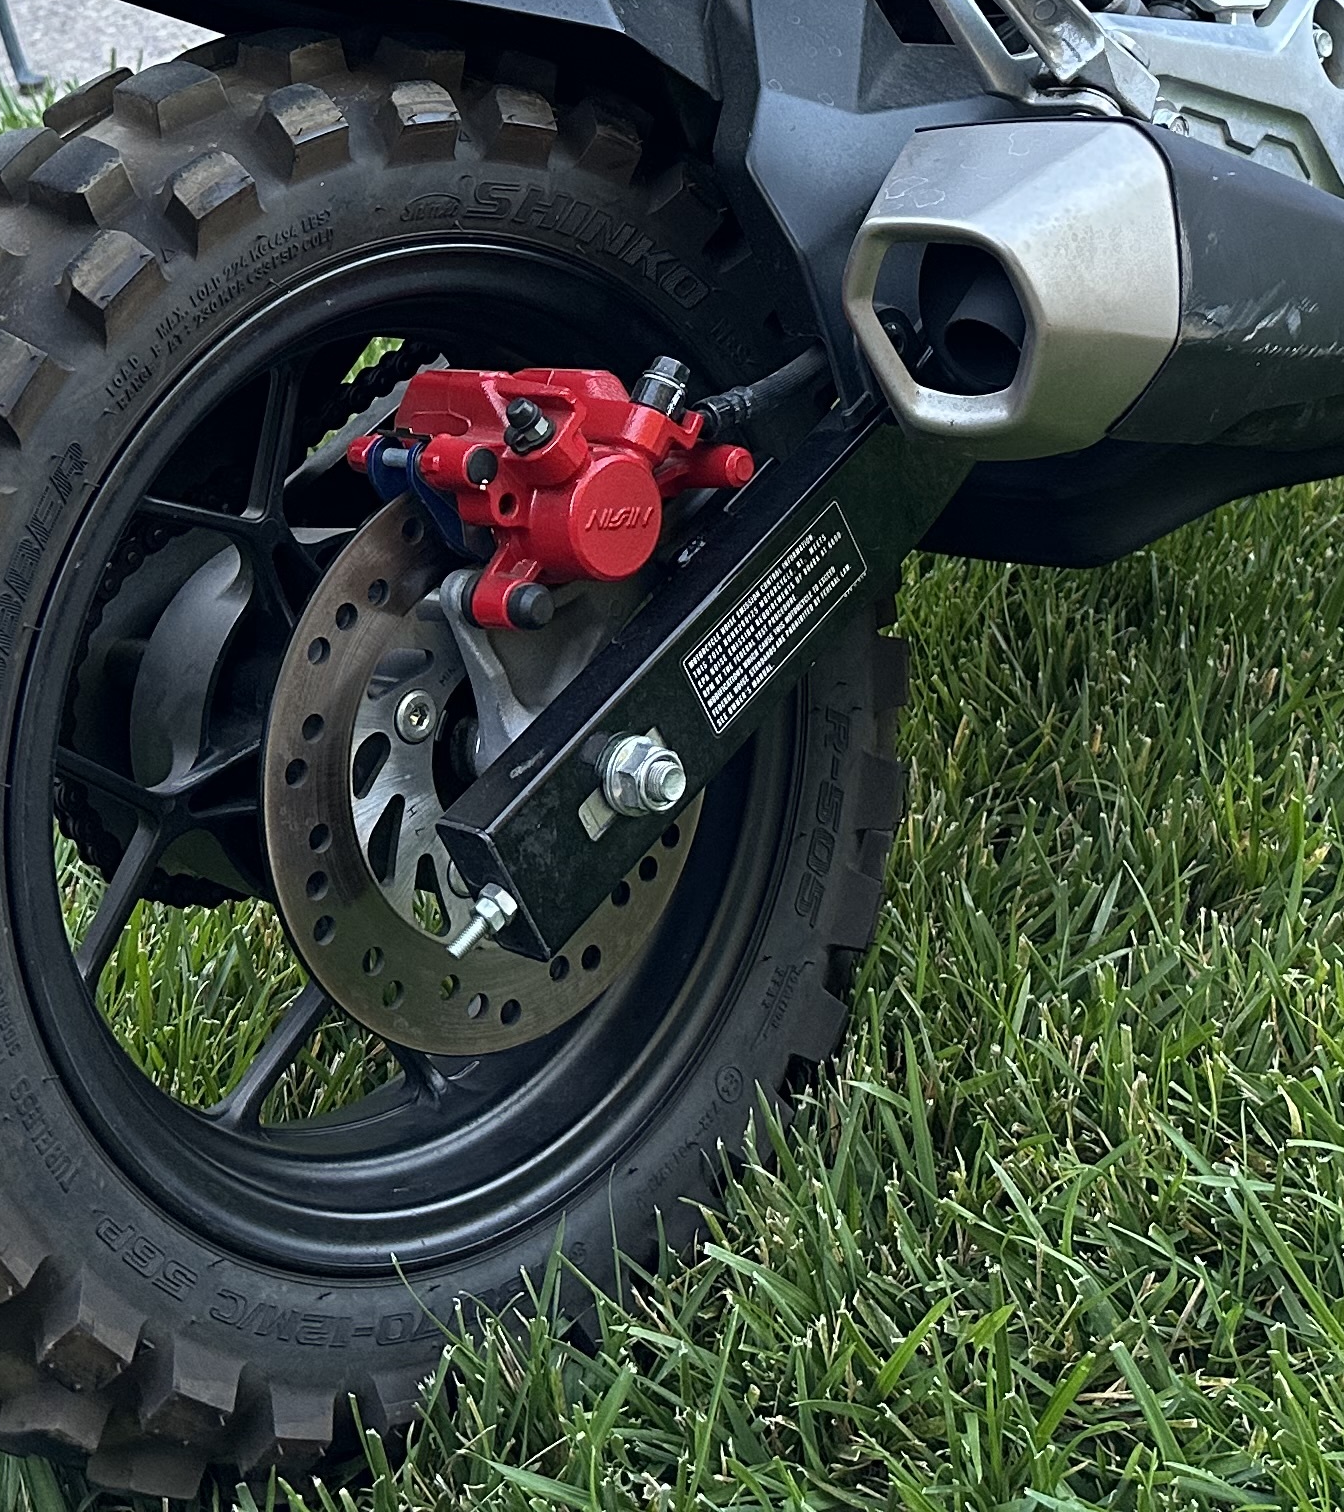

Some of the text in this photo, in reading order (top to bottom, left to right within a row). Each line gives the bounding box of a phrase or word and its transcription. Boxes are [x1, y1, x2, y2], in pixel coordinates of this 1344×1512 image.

[464, 180, 711, 311] SHINKO
[808, 532, 827, 556] MEETS
[709, 653, 728, 676] NOISE
[727, 623, 756, 657] EMISSION
[754, 580, 795, 627] REQUIREMENTS
[733, 637, 756, 665] FEDERAL
[711, 690, 734, 718] FEDERAL
[793, 704, 853, 929] R-505
[9, 1075, 80, 1194] TUBELESS
